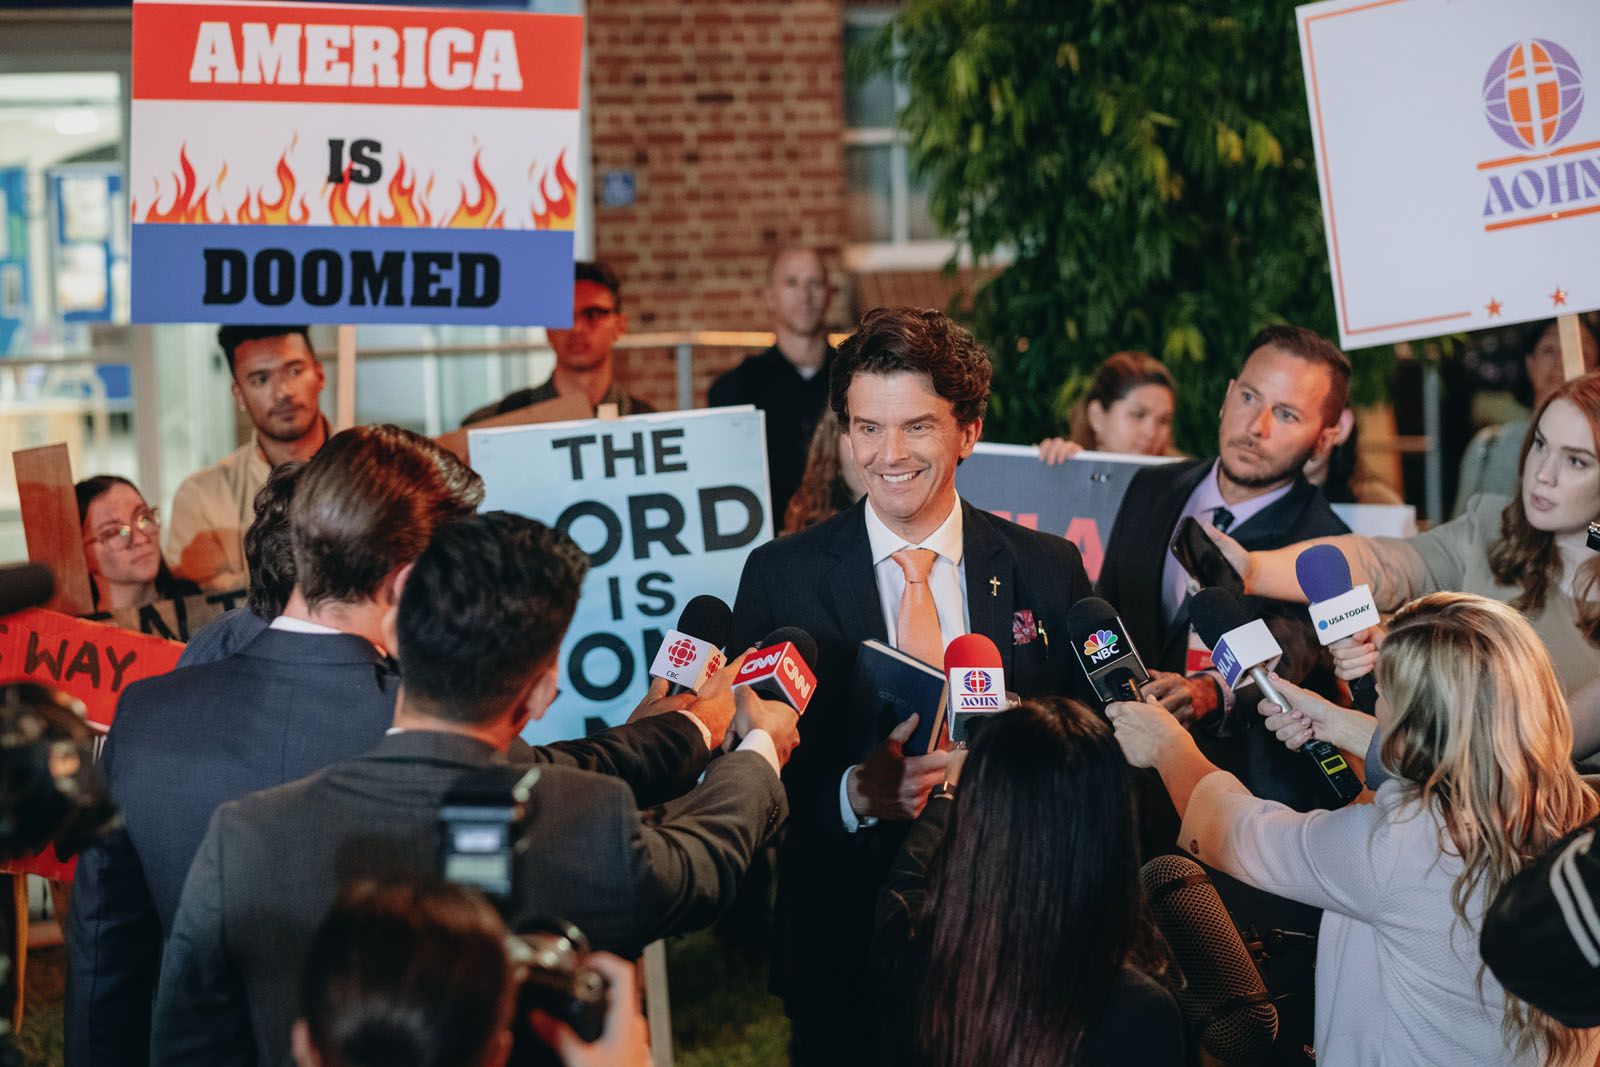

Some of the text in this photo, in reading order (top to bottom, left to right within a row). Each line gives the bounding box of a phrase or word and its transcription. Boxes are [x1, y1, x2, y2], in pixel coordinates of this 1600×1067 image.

[189, 21, 523, 92] AMERICA
[327, 139, 383, 185] IS
[202, 248, 501, 308] DOOMED
[551, 428, 688, 480] THE
[555, 485, 764, 568] ORD
[608, 571, 676, 620] IS
[1329, 604, 1370, 625] USA TODAY
[24, 630, 138, 693] WAY
[666, 670, 680, 680] CBC
[740, 651, 782, 675] CNN
[1091, 643, 1120, 665] NBC
[1216, 647, 1236, 680] HLN
[783, 656, 811, 699] CNN
